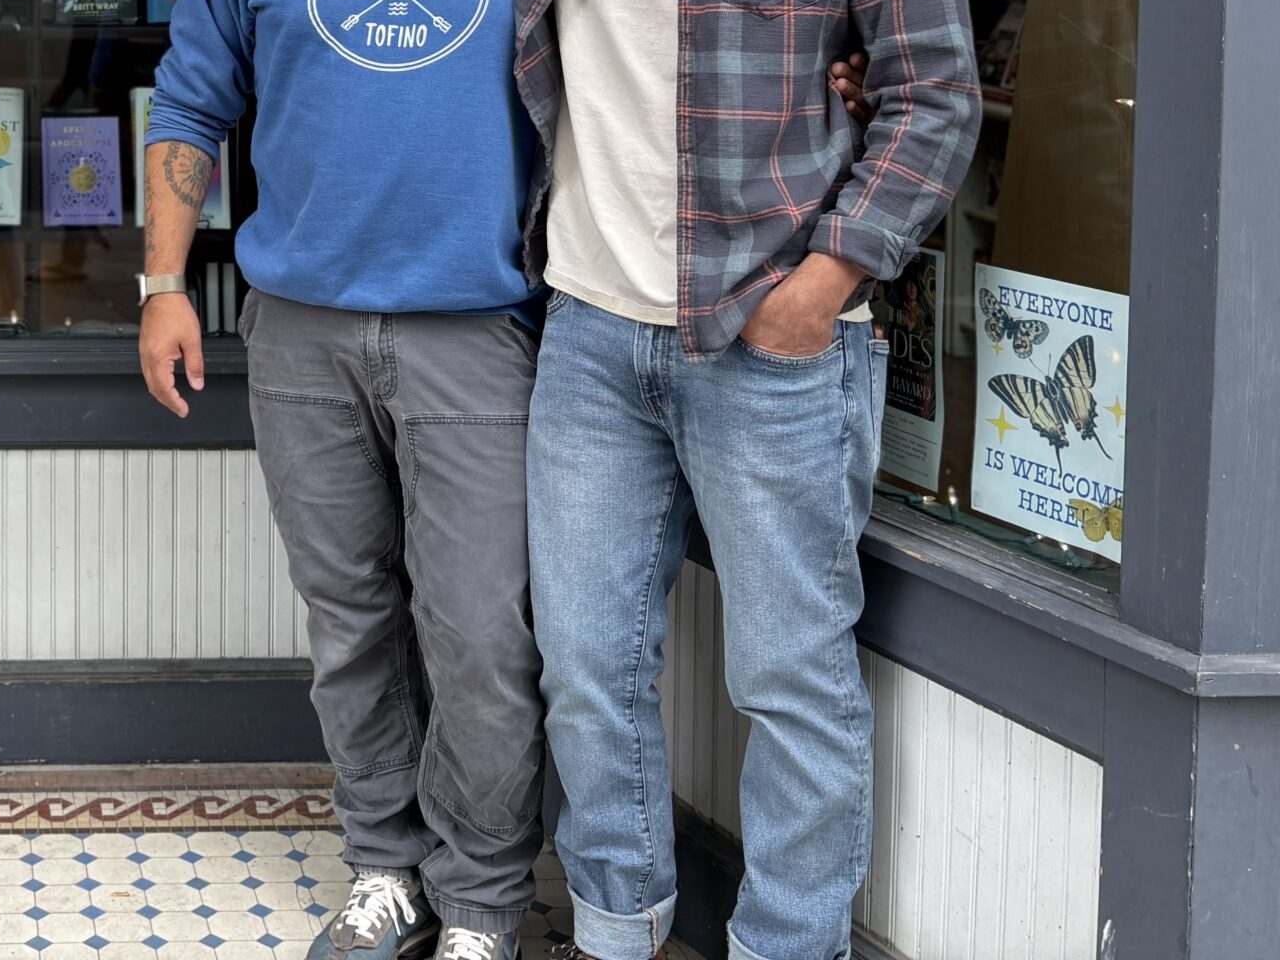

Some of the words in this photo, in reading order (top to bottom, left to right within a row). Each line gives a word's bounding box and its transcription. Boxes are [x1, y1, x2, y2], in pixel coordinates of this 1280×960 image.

[73, 3, 95, 11] BRITT
[365, 22, 428, 48] TOFINO
[998, 285, 1113, 331] EVERYONE
[892, 375, 931, 400] BAYARD
[985, 447, 1005, 471] IS
[1010, 454, 1123, 508] WELCOME
[1018, 488, 1086, 529] HERE!
